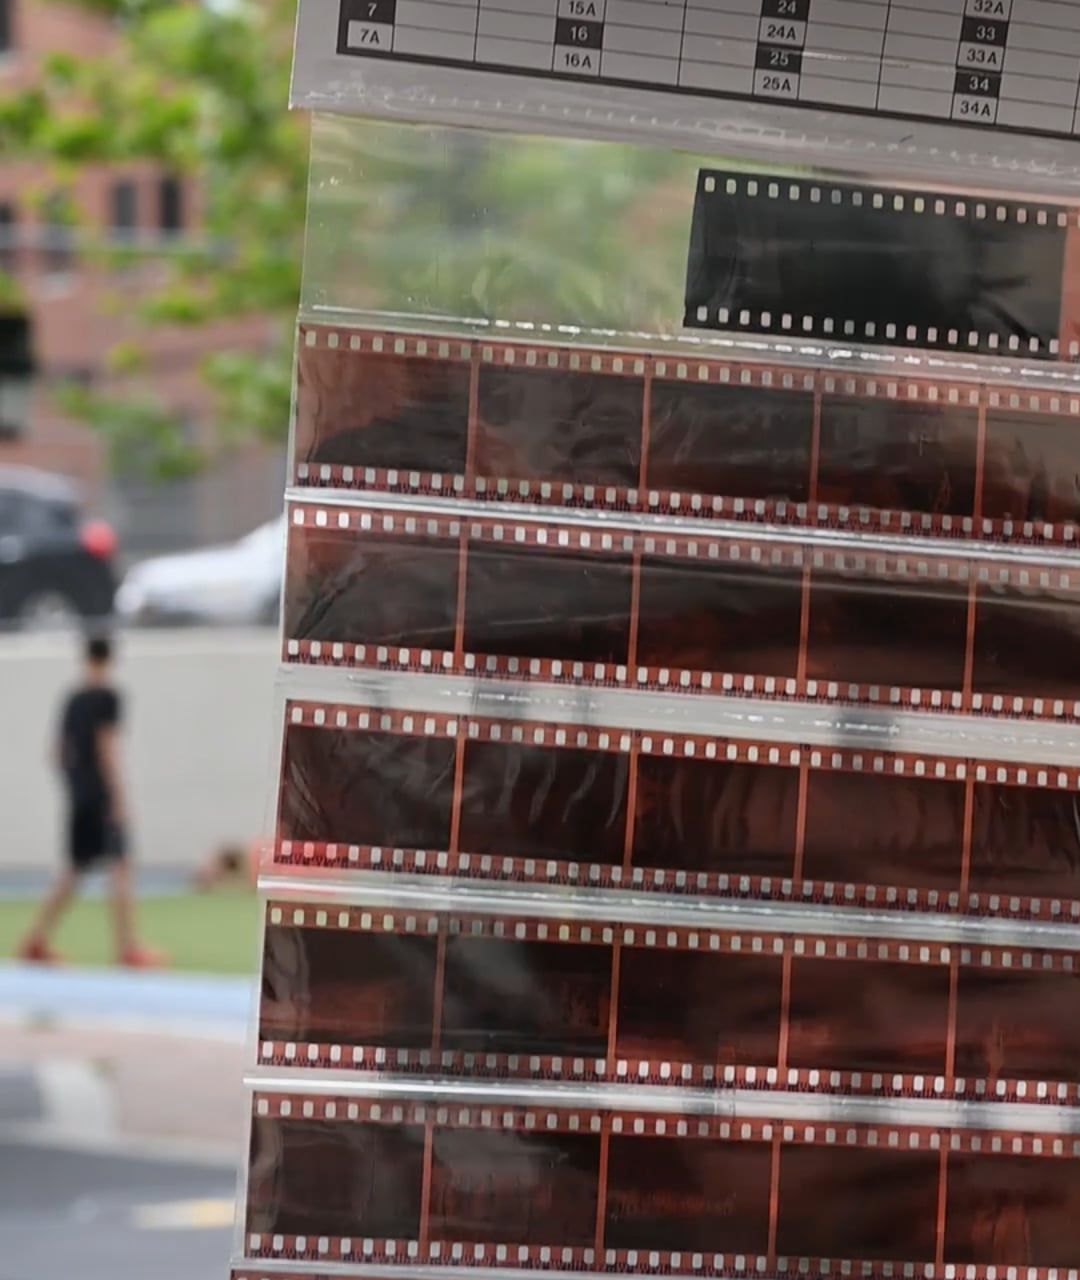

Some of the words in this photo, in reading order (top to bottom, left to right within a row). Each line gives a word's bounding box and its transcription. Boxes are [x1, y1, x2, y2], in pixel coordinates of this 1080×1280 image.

[368, 3, 377, 17] 7
[569, 0, 596, 16] 15A
[777, 0, 797, 14] 24
[361, 28, 380, 44] 7A
[571, 26, 588, 41] 16
[767, 24, 797, 41] 24A
[976, 25, 996, 40] 33
[564, 53, 592, 68] 16A
[770, 51, 789, 66] 25
[966, 48, 997, 65] 33A
[762, 76, 791, 92] 25A
[969, 76, 989, 91] 34
[960, 100, 991, 117] 34A
